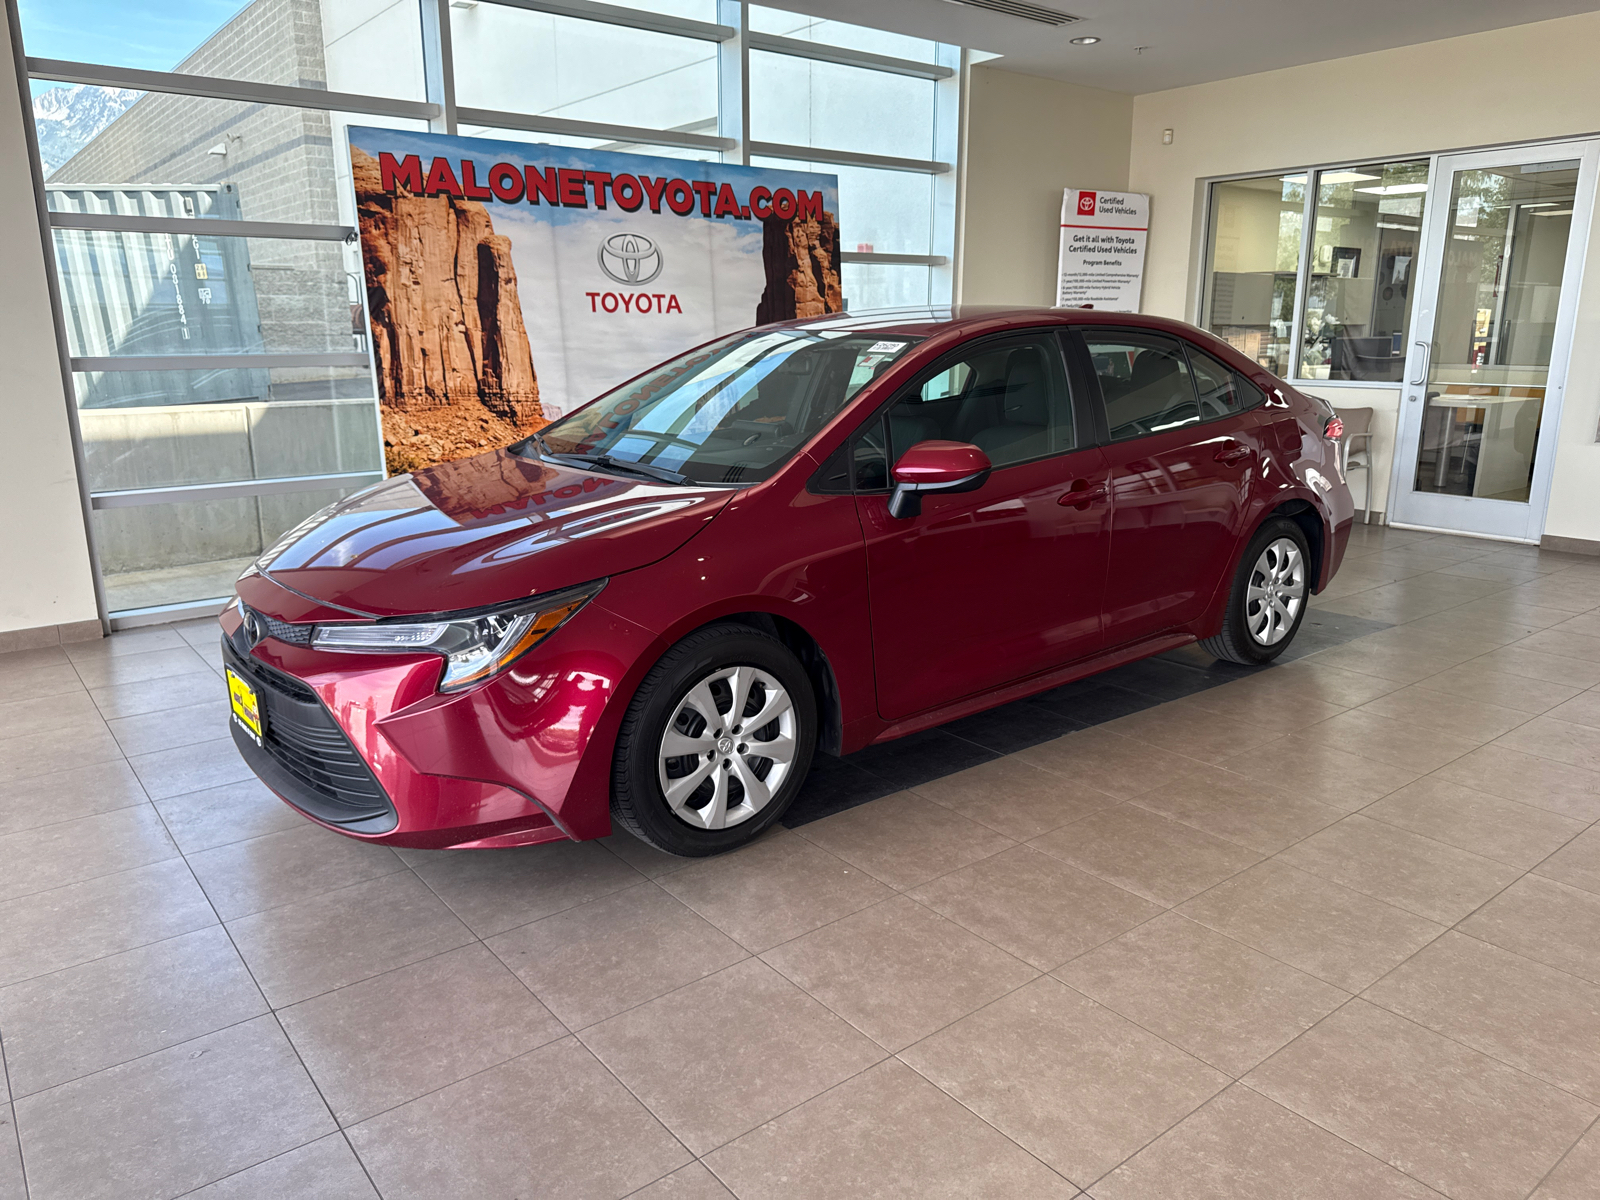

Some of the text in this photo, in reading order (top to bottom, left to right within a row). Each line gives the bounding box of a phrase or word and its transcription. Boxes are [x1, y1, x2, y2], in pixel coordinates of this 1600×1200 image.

[378, 152, 824, 222] MALONETOYOTA.COM
[1100, 196, 1124, 205] Certified
[1114, 207, 1137, 215] Vehicles
[1115, 236, 1135, 245] Toyota
[585, 292, 683, 314] TOYOTA
